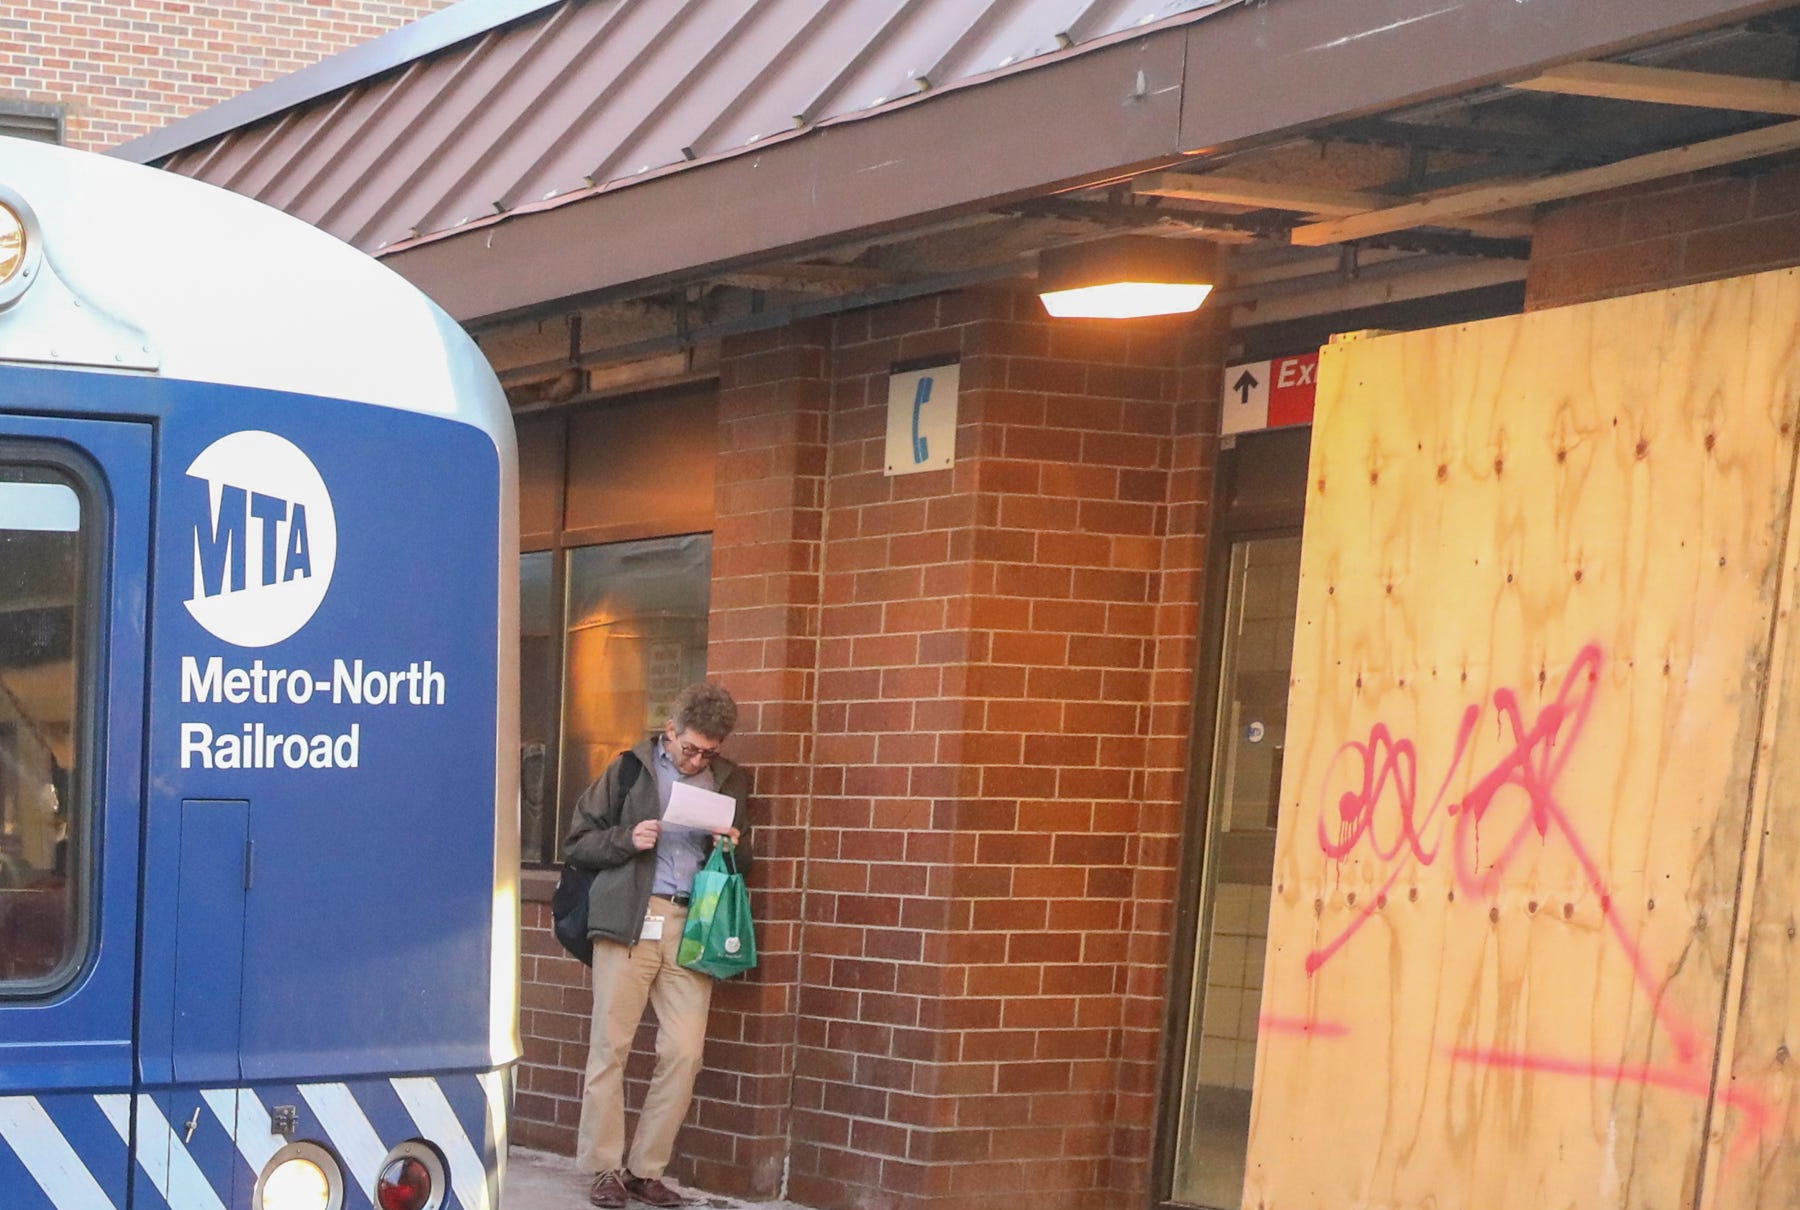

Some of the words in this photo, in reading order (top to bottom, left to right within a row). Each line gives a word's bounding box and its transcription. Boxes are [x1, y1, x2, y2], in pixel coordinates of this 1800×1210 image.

[194, 477, 311, 598] MTA
[180, 656, 446, 706] Metro-North
[180, 722, 361, 770] Railroad
